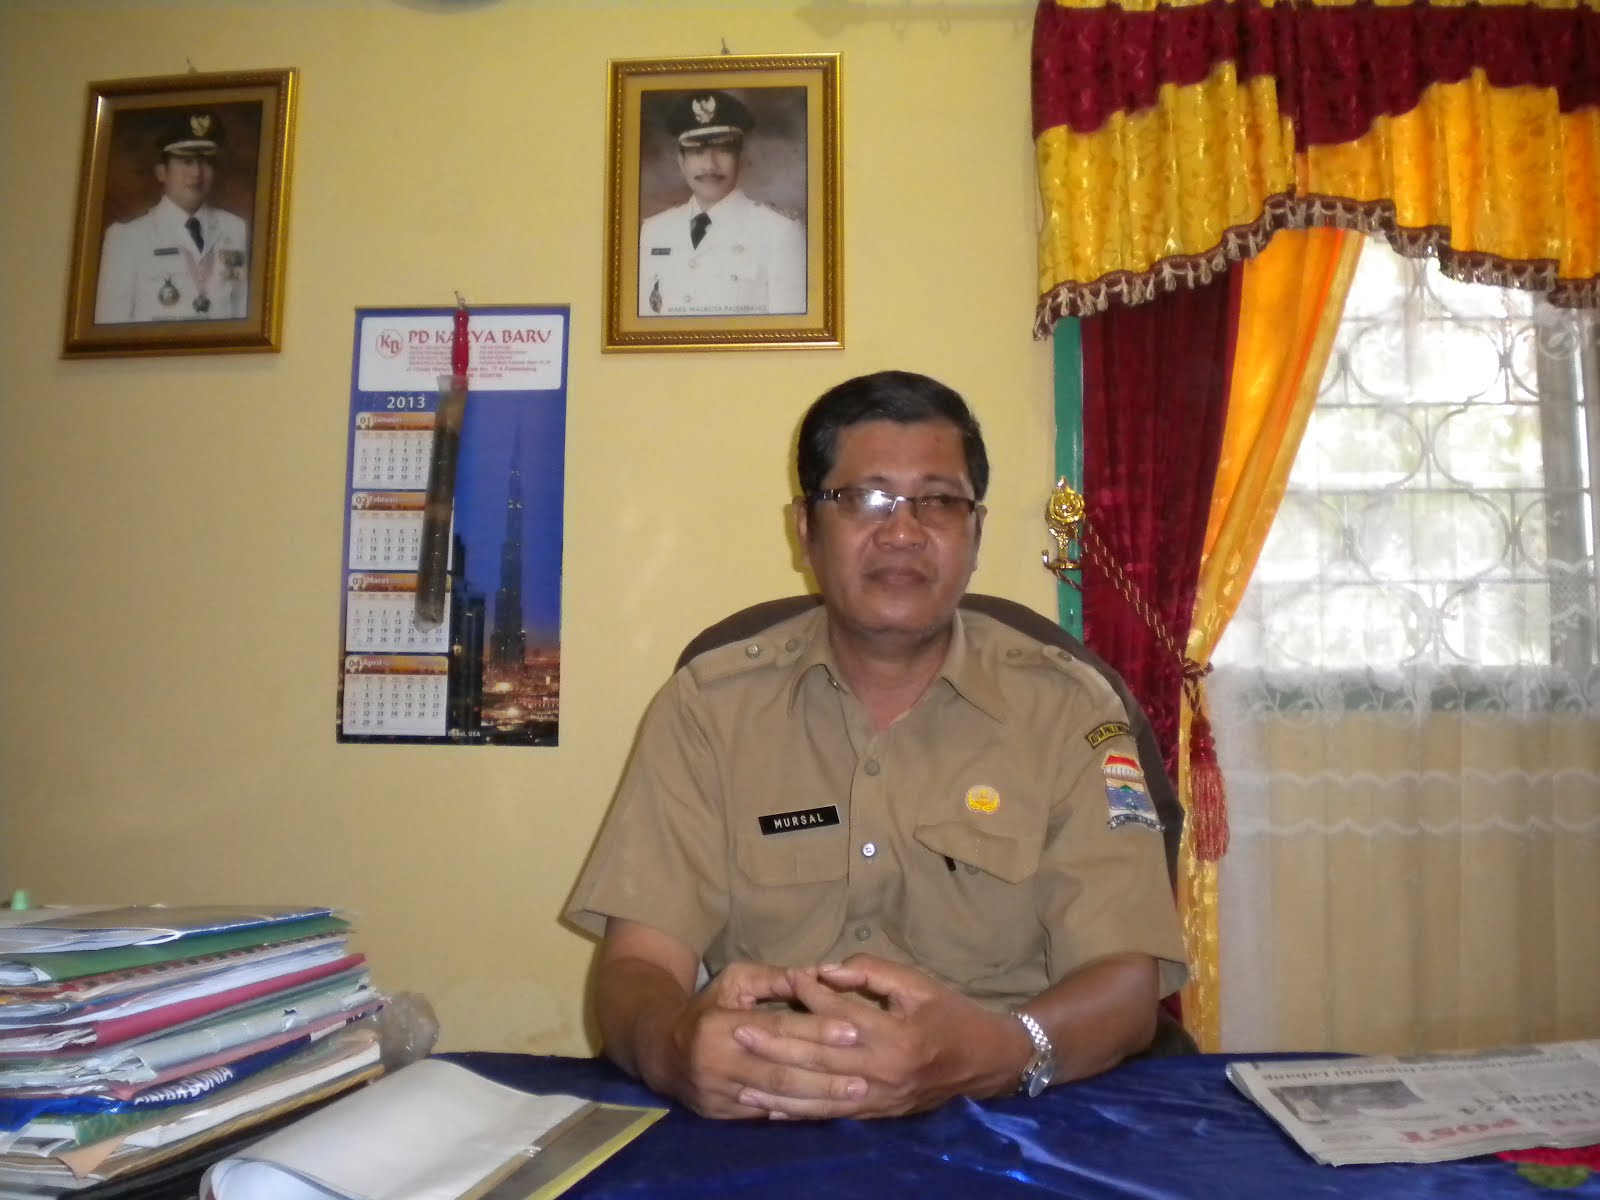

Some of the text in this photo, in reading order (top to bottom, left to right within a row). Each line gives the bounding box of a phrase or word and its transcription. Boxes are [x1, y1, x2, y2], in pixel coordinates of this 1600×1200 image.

[408, 330, 552, 344] PD KAYA BARU
[386, 396, 426, 409] 2013
[360, 416, 372, 424] 01
[364, 660, 382, 668] April
[774, 813, 824, 829] MURSAL
